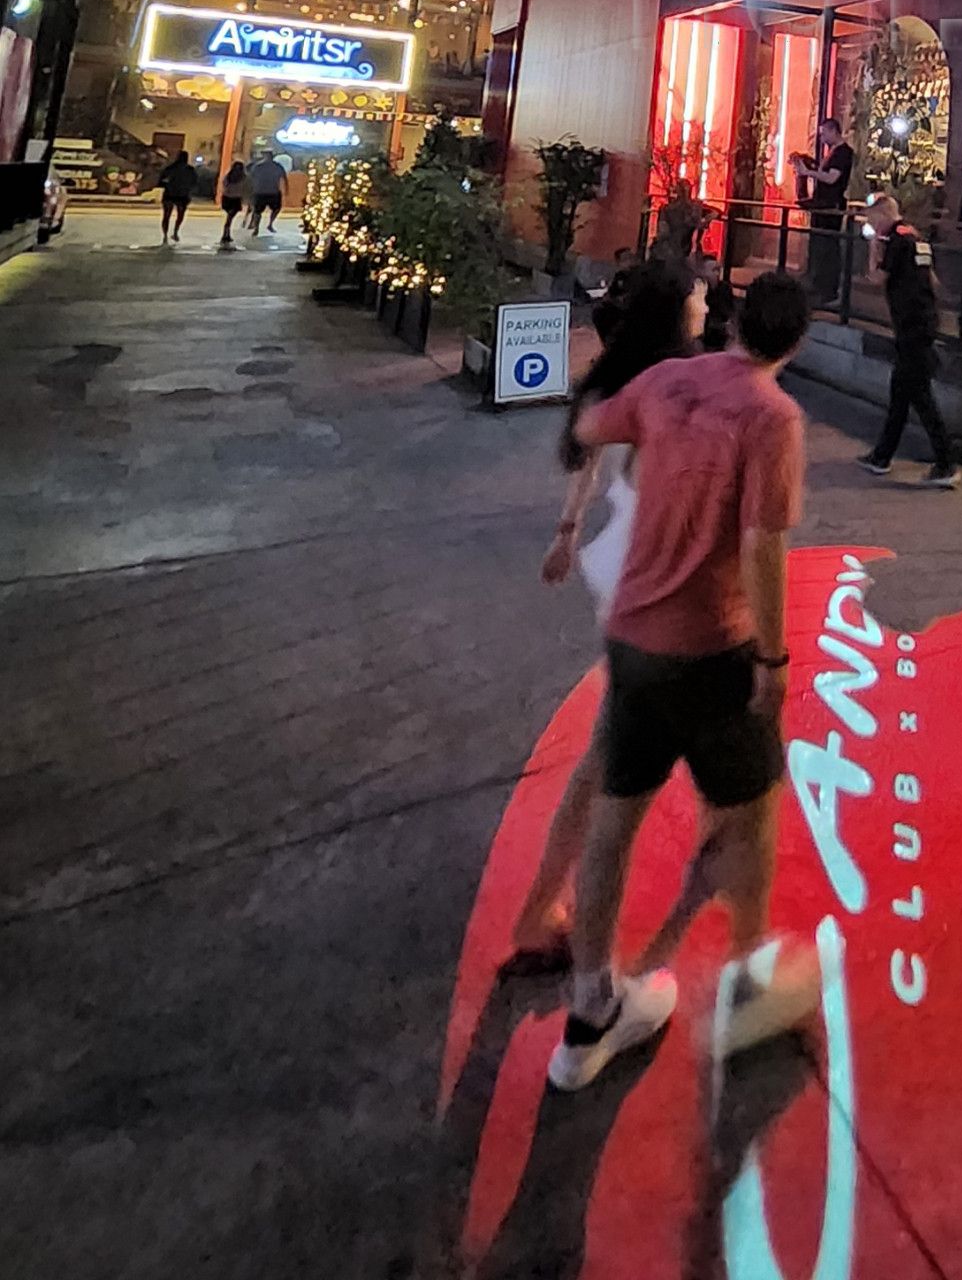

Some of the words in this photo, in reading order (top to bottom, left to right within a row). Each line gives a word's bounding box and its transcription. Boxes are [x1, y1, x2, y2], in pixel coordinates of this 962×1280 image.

[505, 317, 562, 332] PARKING
[505, 333, 561, 347] AVAILABLE
[522, 358, 544, 383] P
[890, 772, 927, 1006] CLUB
